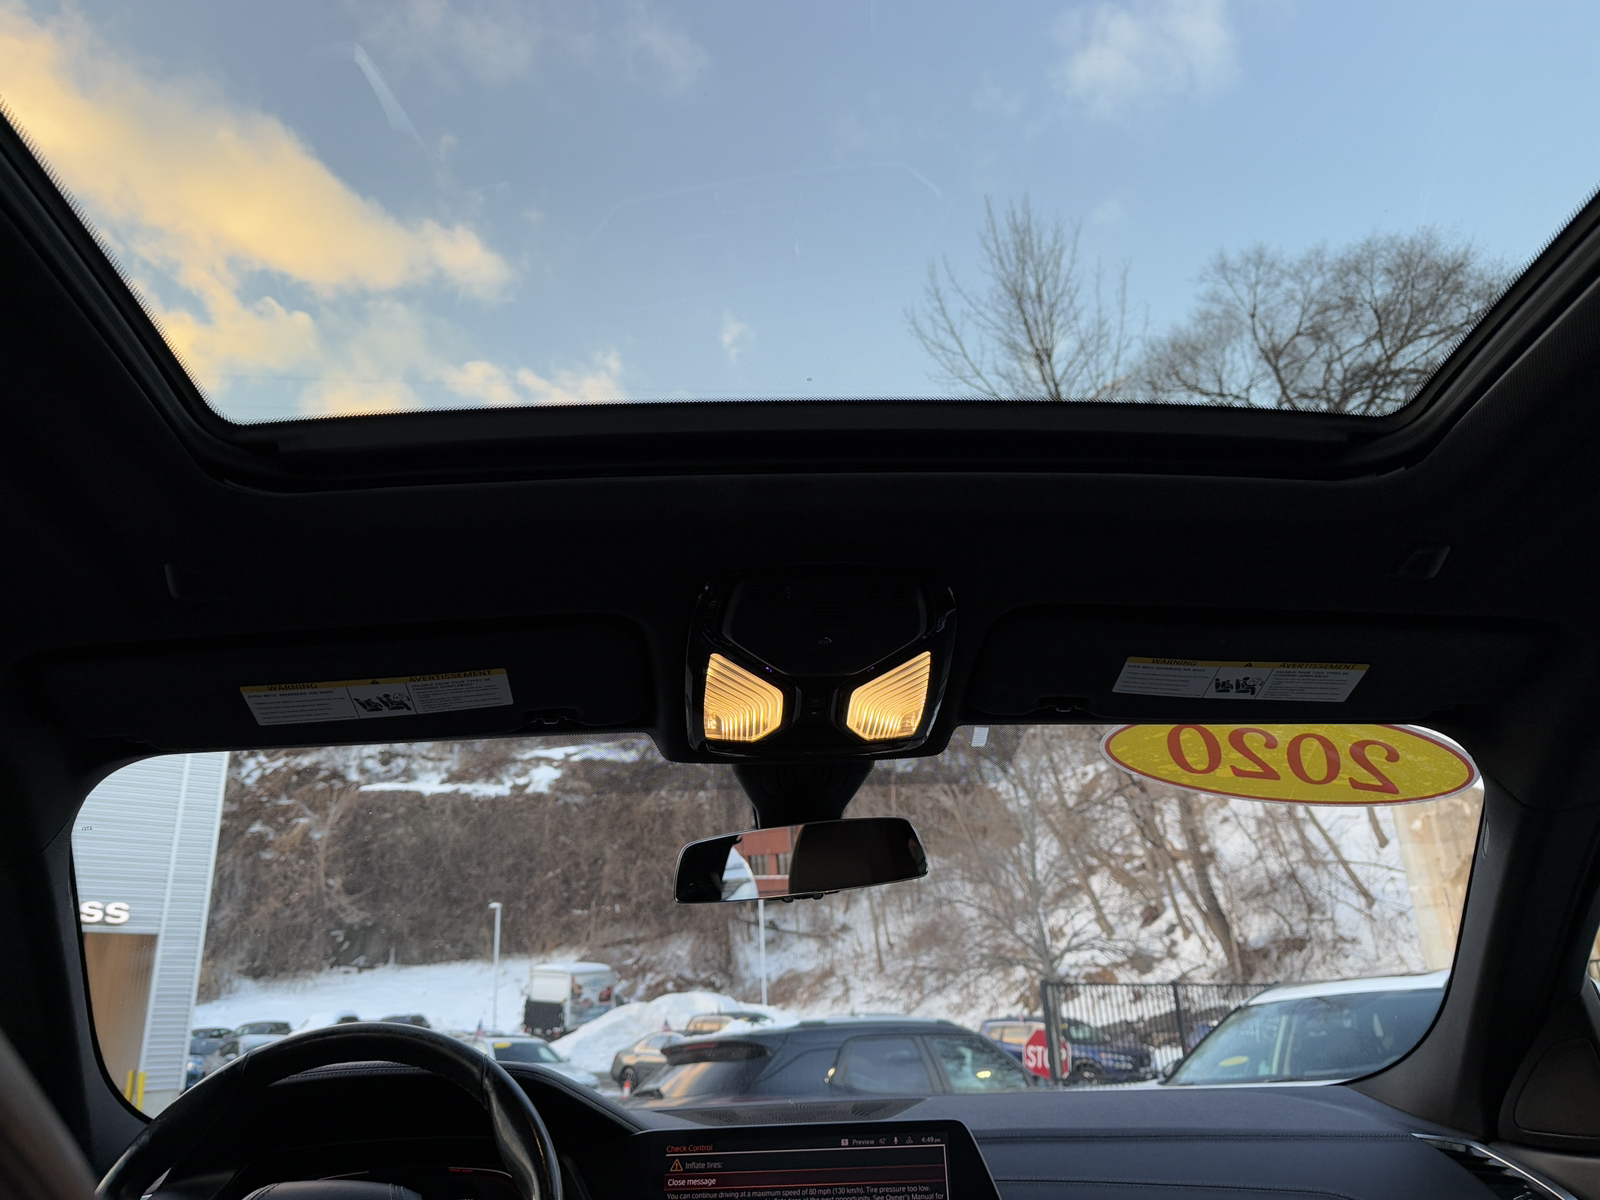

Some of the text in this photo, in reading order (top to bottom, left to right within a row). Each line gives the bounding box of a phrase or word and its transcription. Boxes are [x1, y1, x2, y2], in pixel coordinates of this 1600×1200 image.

[1152, 658, 1197, 666] WARNING
[1279, 662, 1358, 670] AVERTISSEMENT
[409, 671, 491, 682] AVERTISSEMENT
[267, 683, 317, 691] WARNING
[666, 1144, 713, 1153] Check Control
[685, 1161, 723, 1169] Inflate tires:
[667, 1177, 717, 1187] Close message
[667, 1192, 678, 1200] You
[718, 1191, 739, 1199] driving
[782, 1188, 801, 1197] speed
[817, 1188, 832, 1196] mph
[832, 1187, 846, 1195] (130
[865, 1185, 879, 1193] Tire
[879, 1186, 906, 1194] pressure
[918, 1184, 931, 1192] low.
[911, 1192, 935, 1200] Manual
